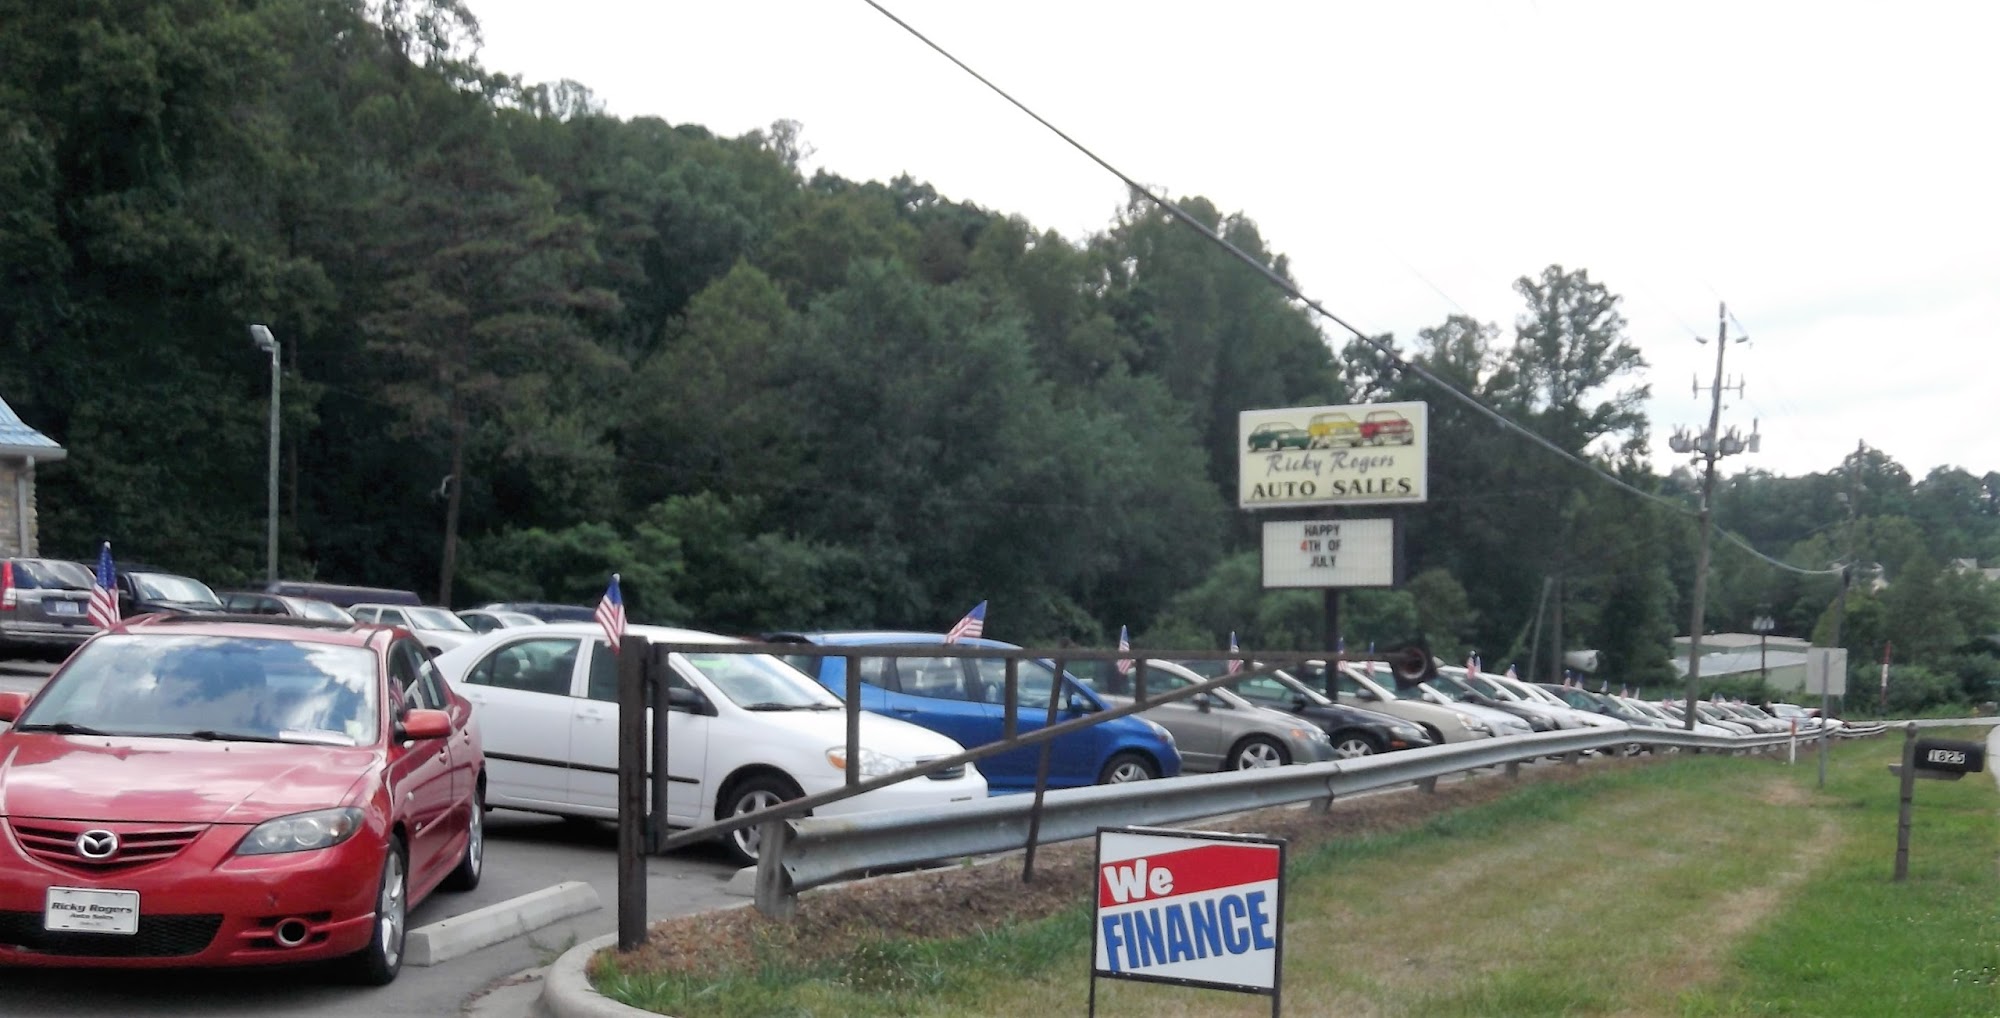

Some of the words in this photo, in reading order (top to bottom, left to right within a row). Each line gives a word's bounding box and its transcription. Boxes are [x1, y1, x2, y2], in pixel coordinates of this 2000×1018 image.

[1266, 452, 1322, 476] Ricky
[1330, 450, 1394, 473] Rogers
[1252, 480, 1317, 499] AUTO
[1332, 476, 1412, 496] SALES
[1304, 524, 1340, 536] HAPPY
[1300, 540, 1321, 552] 4TH
[1328, 539, 1341, 551] OF
[1310, 556, 1336, 568] JULY
[1930, 750, 1965, 763] 1825
[1102, 858, 1174, 903] We
[51, 902, 86, 913] Ricky
[89, 904, 133, 914] Rogers
[1101, 890, 1275, 973] FINANCE
